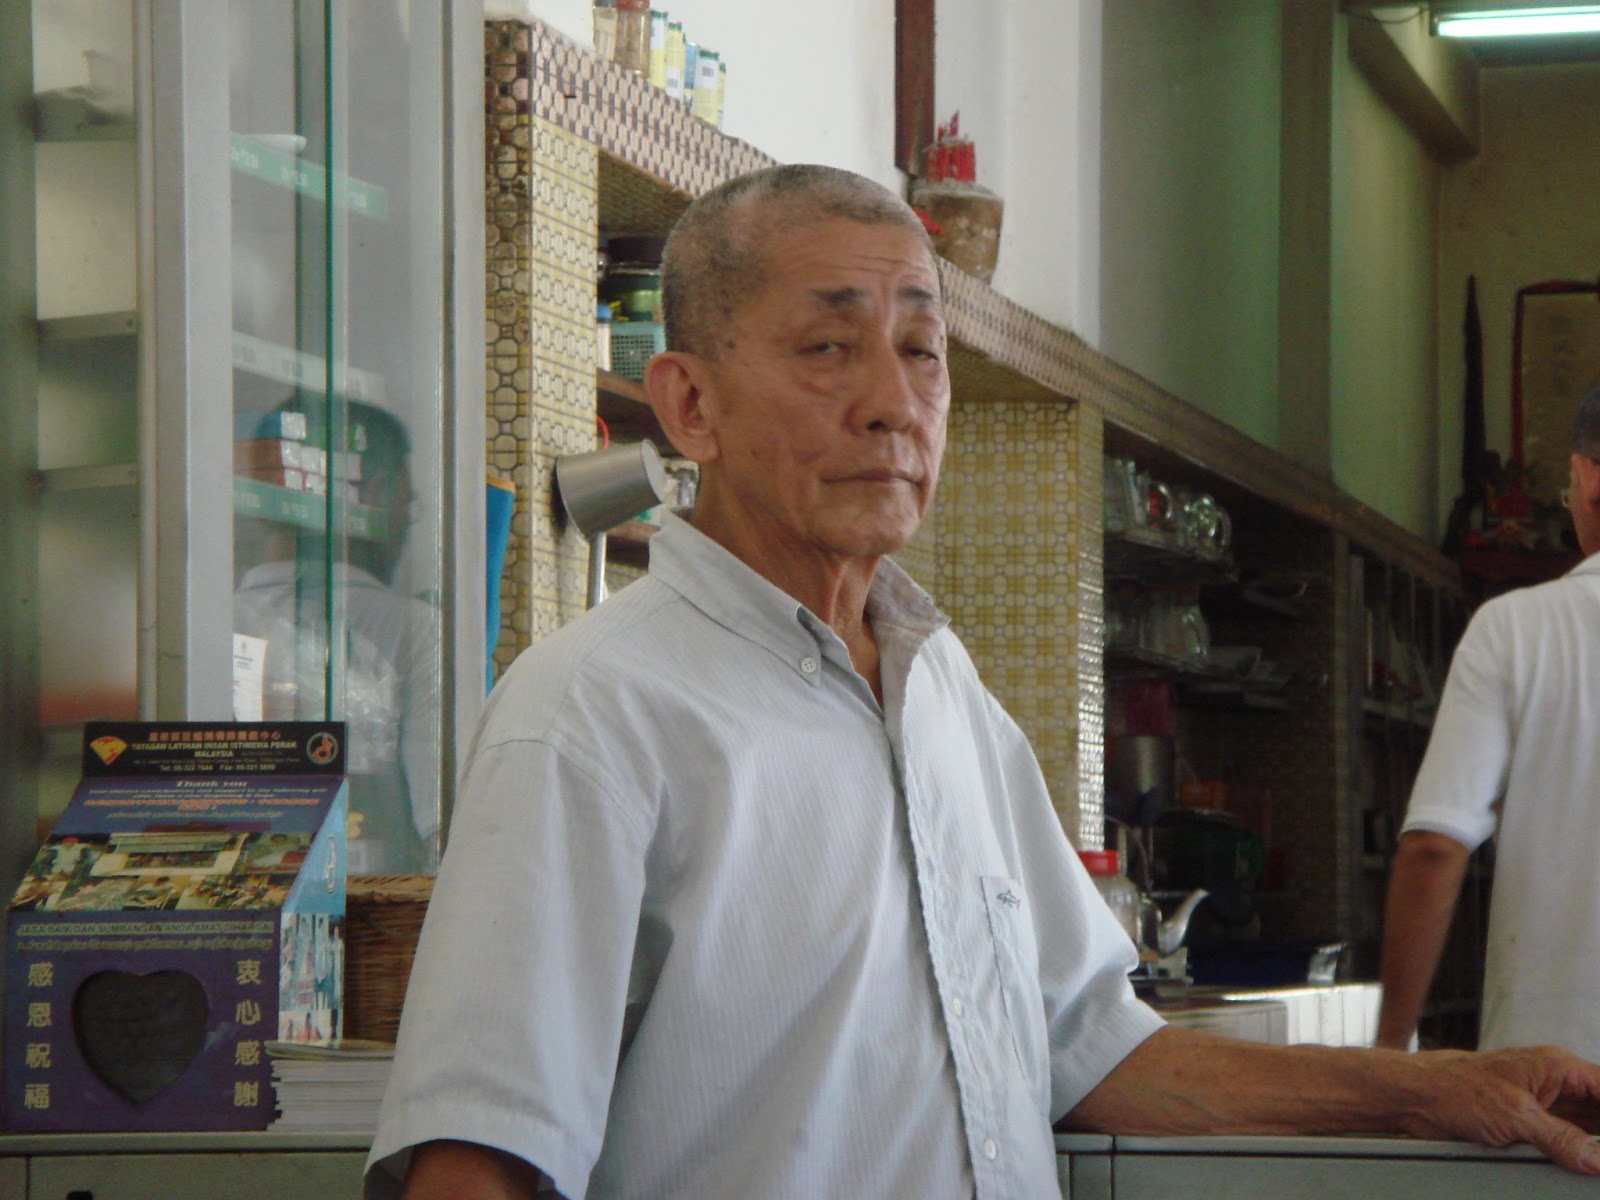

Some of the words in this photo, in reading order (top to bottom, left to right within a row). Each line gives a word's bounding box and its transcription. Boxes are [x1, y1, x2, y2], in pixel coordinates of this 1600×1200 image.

[168, 742, 203, 750] LATIHAN
[203, 742, 229, 750] INSAN
[229, 741, 269, 749] ISTIMEWA
[270, 741, 297, 749] PERAK
[194, 750, 234, 758] MALAYSIA
[98, 923, 163, 933] SUMBANGAN
[24, 961, 54, 1110] 感恩祝福
[234, 959, 262, 1107] 衷心感謝
